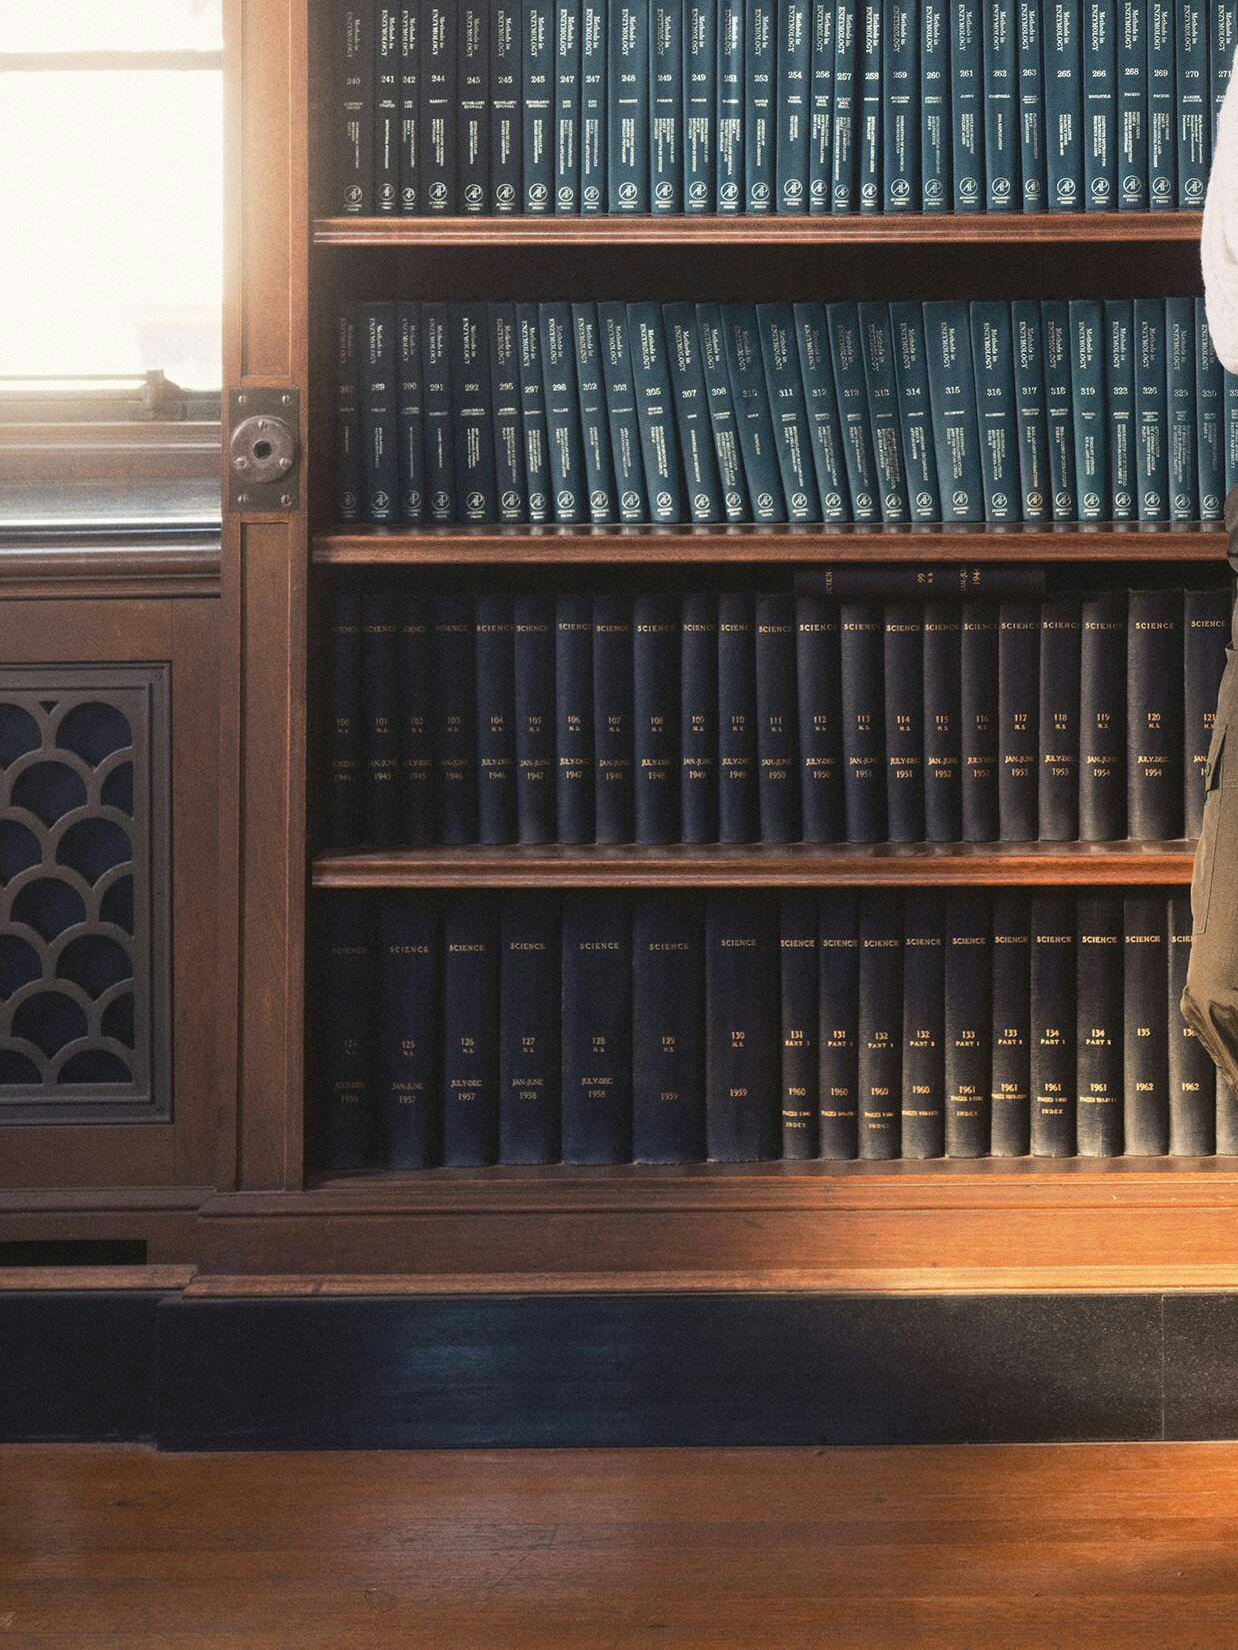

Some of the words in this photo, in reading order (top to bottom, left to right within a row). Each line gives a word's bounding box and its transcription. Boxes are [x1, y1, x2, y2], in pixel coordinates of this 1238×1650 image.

[788, 71, 802, 79] 254
[682, 389, 696, 398] 307
[779, 389, 793, 397] 311
[945, 386, 960, 394] 315
[1022, 387, 1037, 395] 317
[1081, 387, 1095, 395] 319
[1148, 713, 1160, 721] 120
[896, 770, 912, 778] 1951
[790, 1031, 803, 1039] 131
[1046, 1029, 1059, 1037] 134
[1137, 1028, 1150, 1036] 135
[1044, 1083, 1061, 1091] 1961
[1136, 1083, 1153, 1091] 1962
